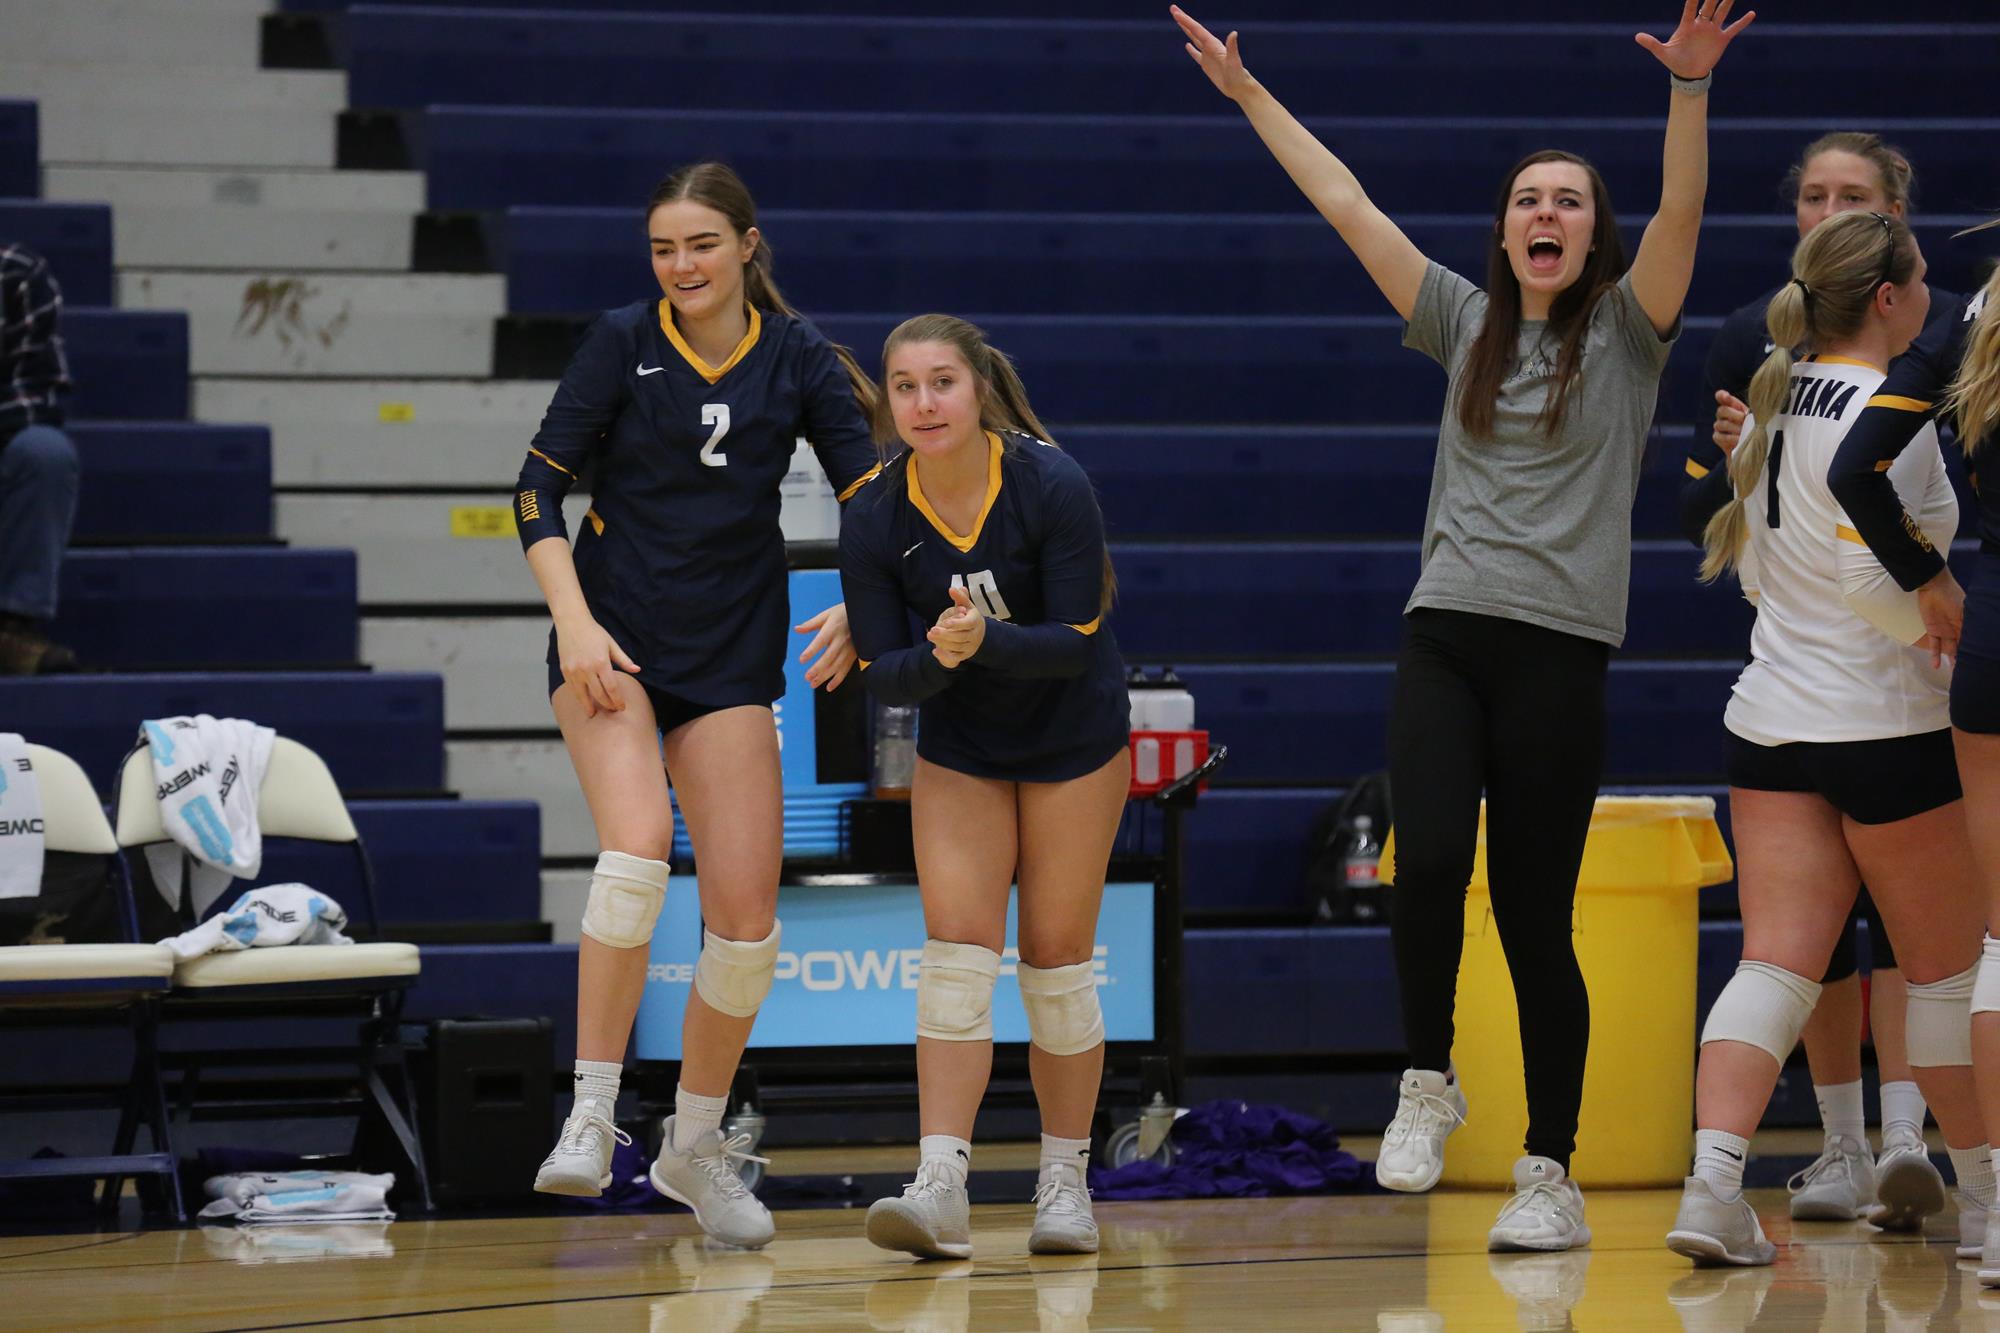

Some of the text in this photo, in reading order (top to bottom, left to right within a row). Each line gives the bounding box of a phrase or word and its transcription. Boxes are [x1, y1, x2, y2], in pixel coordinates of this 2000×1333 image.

[700, 403, 731, 467] 2
[1767, 430, 1784, 529] 1
[774, 945, 1109, 991] POWEE
